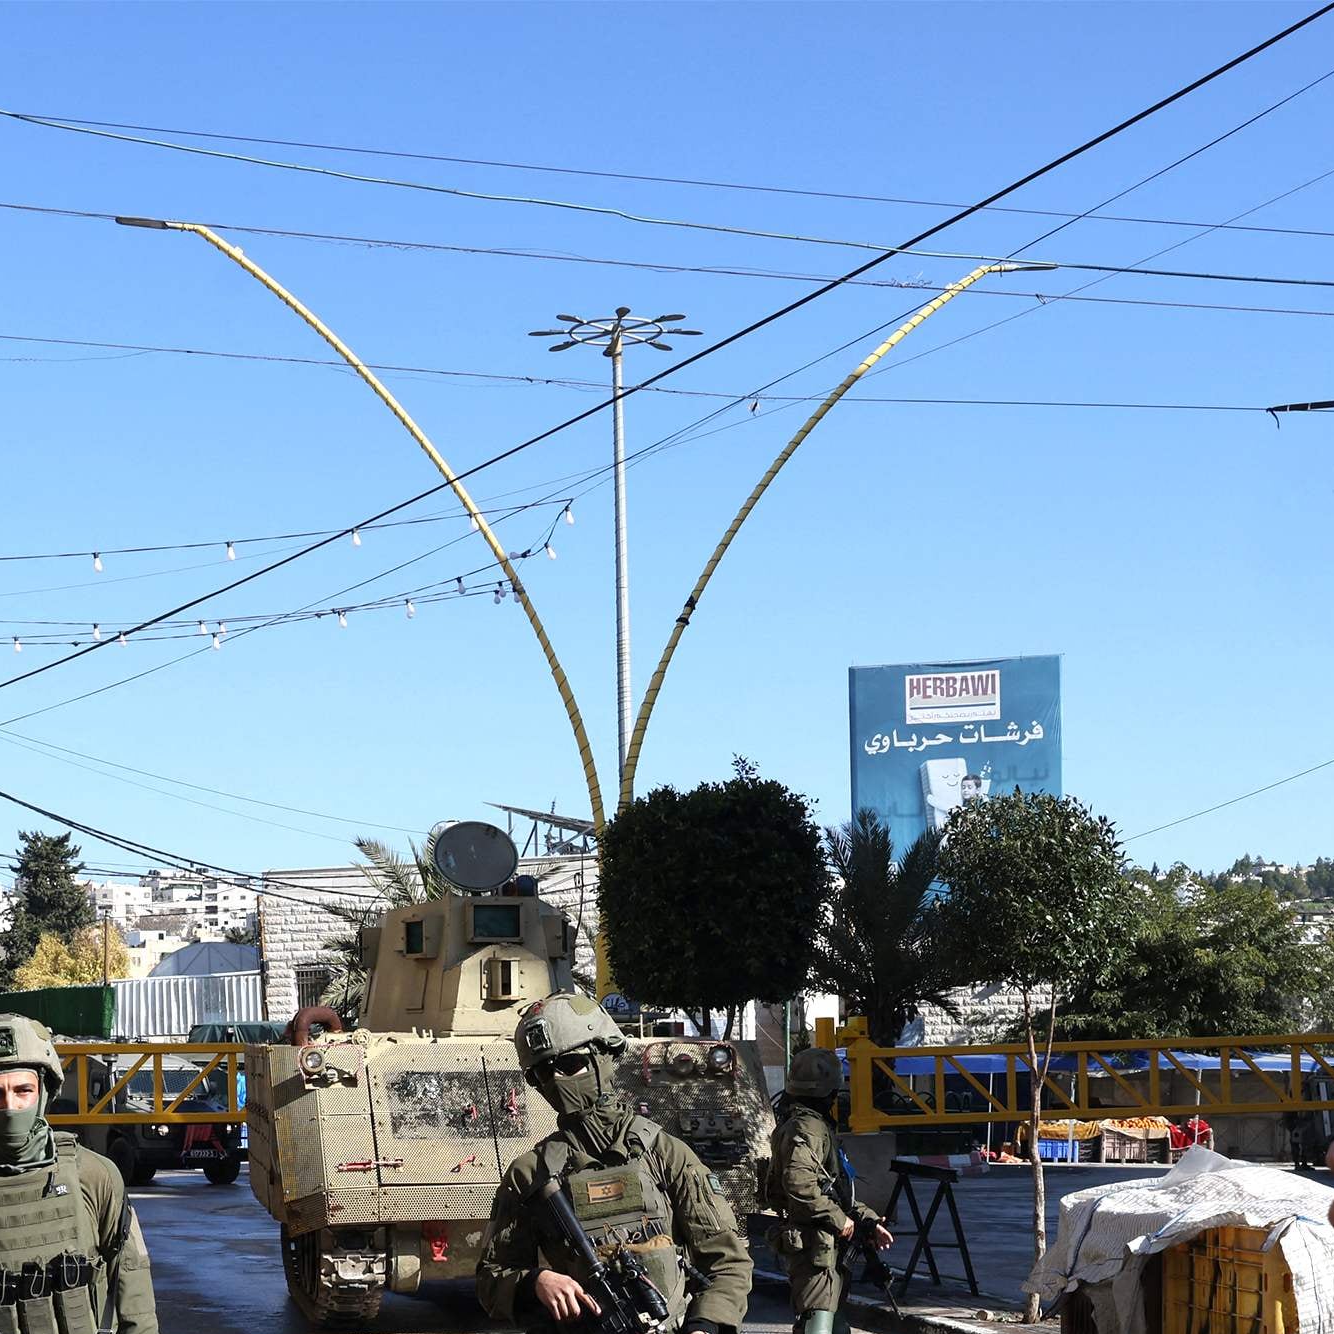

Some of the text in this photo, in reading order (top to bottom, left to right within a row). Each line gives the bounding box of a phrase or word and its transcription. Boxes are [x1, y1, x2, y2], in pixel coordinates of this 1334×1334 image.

[908, 672, 997, 700] HERBAWI
[864, 720, 1045, 756] فرشات حرباوي
